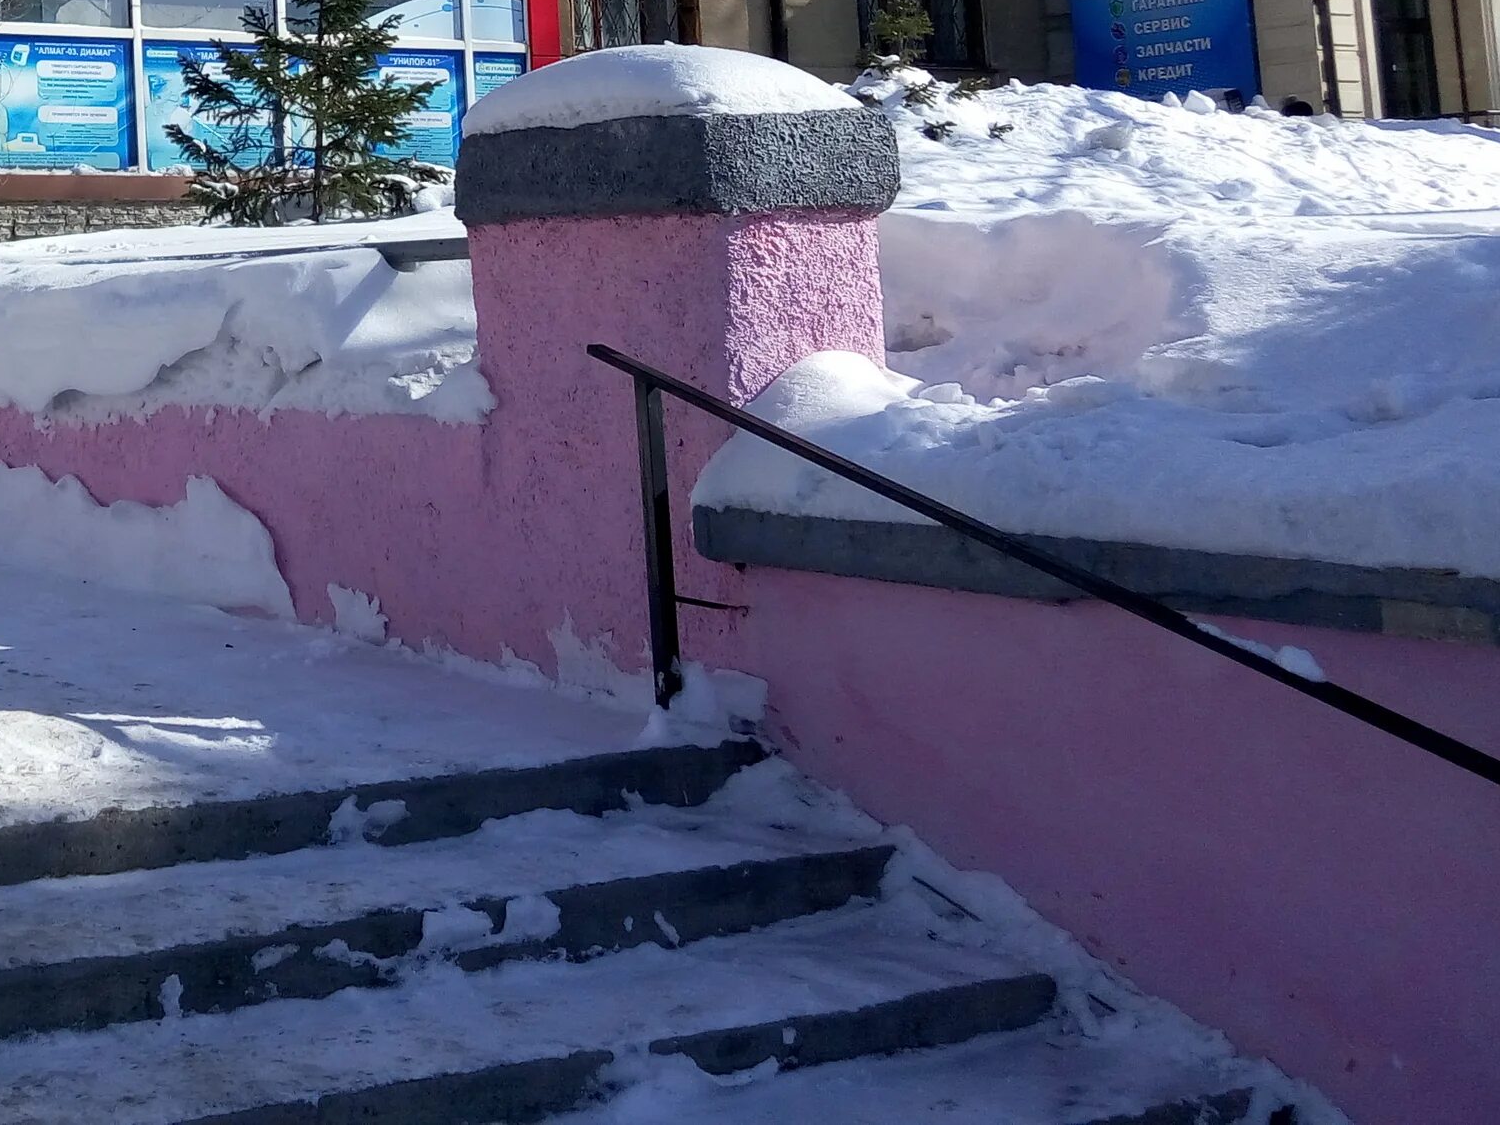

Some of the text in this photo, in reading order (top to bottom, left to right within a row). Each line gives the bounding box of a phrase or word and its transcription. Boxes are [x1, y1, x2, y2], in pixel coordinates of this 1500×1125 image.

[1134, 16, 1191, 35] СЕРВИС
[1136, 38, 1211, 58] ЗАПЧАСТИ
[1138, 64, 1194, 82] КРЕДИТ
